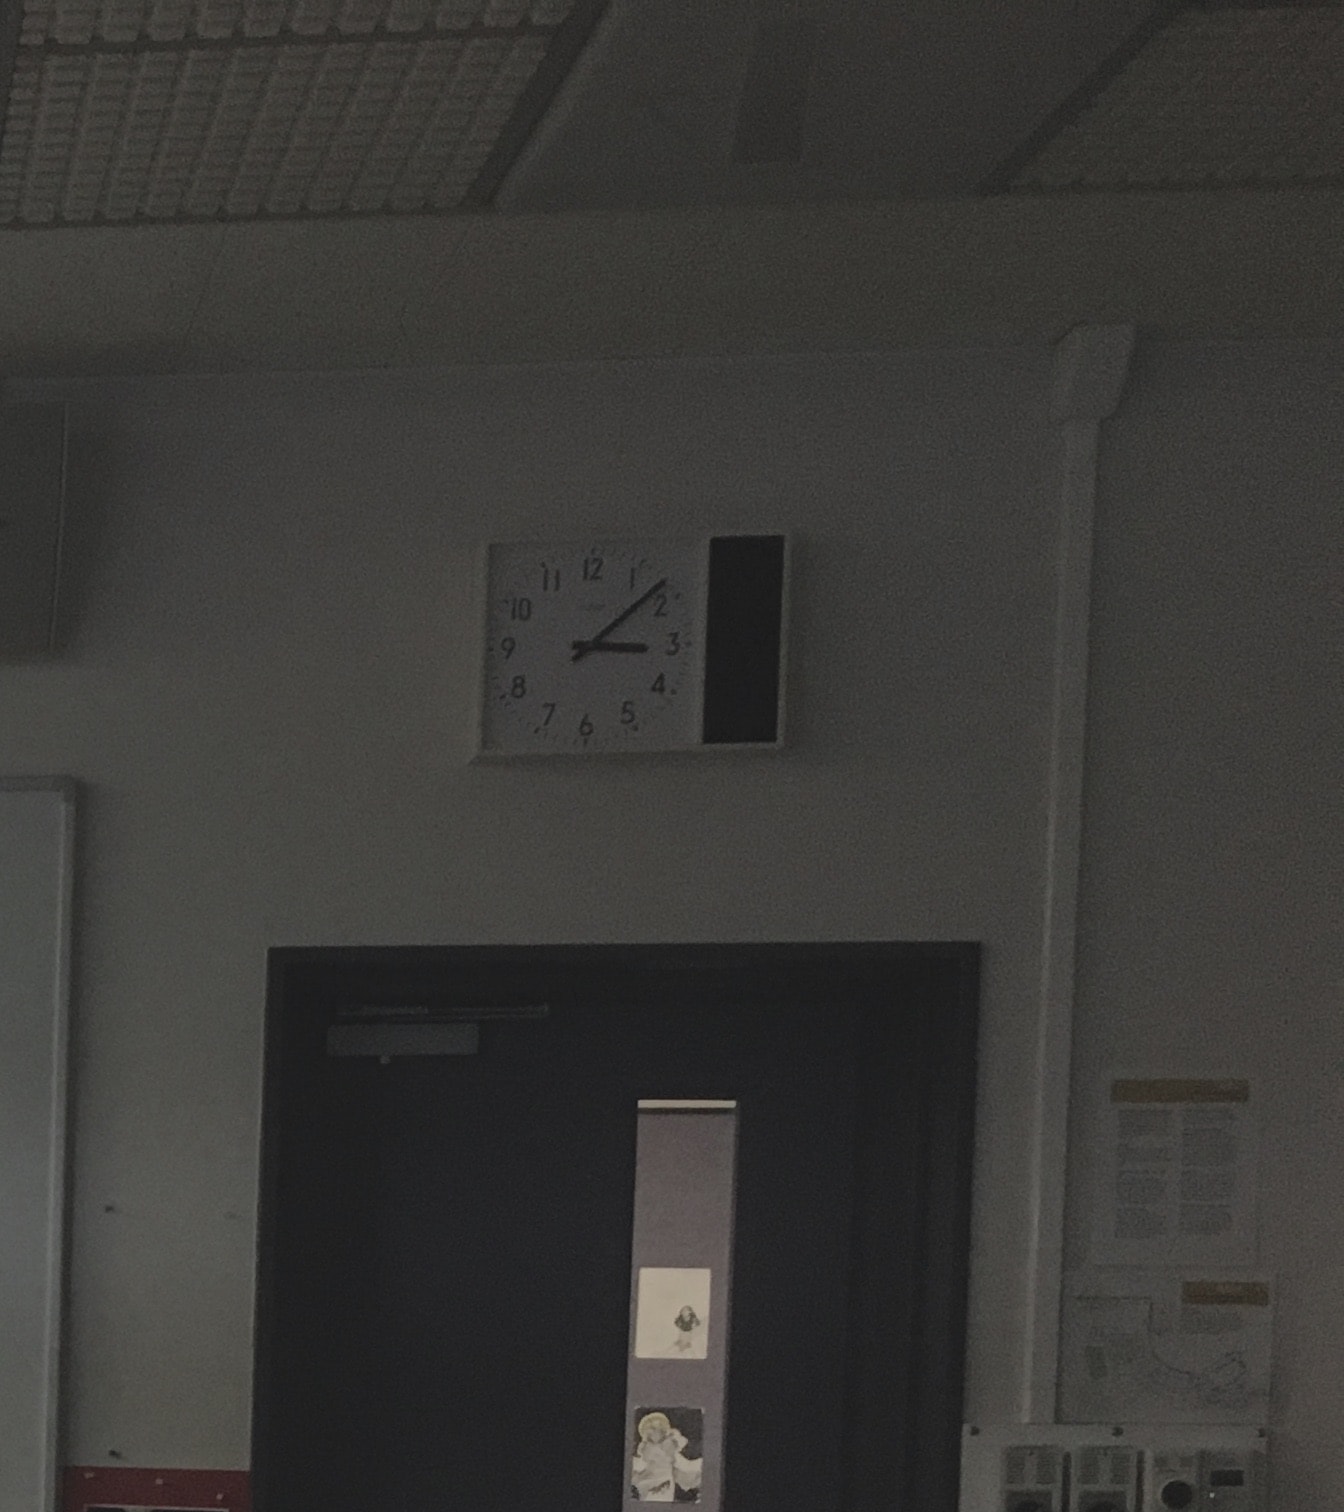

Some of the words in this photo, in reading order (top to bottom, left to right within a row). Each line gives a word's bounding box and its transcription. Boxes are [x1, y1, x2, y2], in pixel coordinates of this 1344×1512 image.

[543, 567, 560, 592] 11
[583, 558, 604, 581] 12
[510, 598, 531, 621] 10
[654, 595, 668, 617] 2
[501, 637, 516, 659] 9
[665, 633, 680, 656] 3
[510, 676, 527, 699] 8
[651, 672, 666, 693] 4
[542, 703, 556, 726] 7
[620, 701, 635, 724] 5
[579, 713, 594, 736] 6
